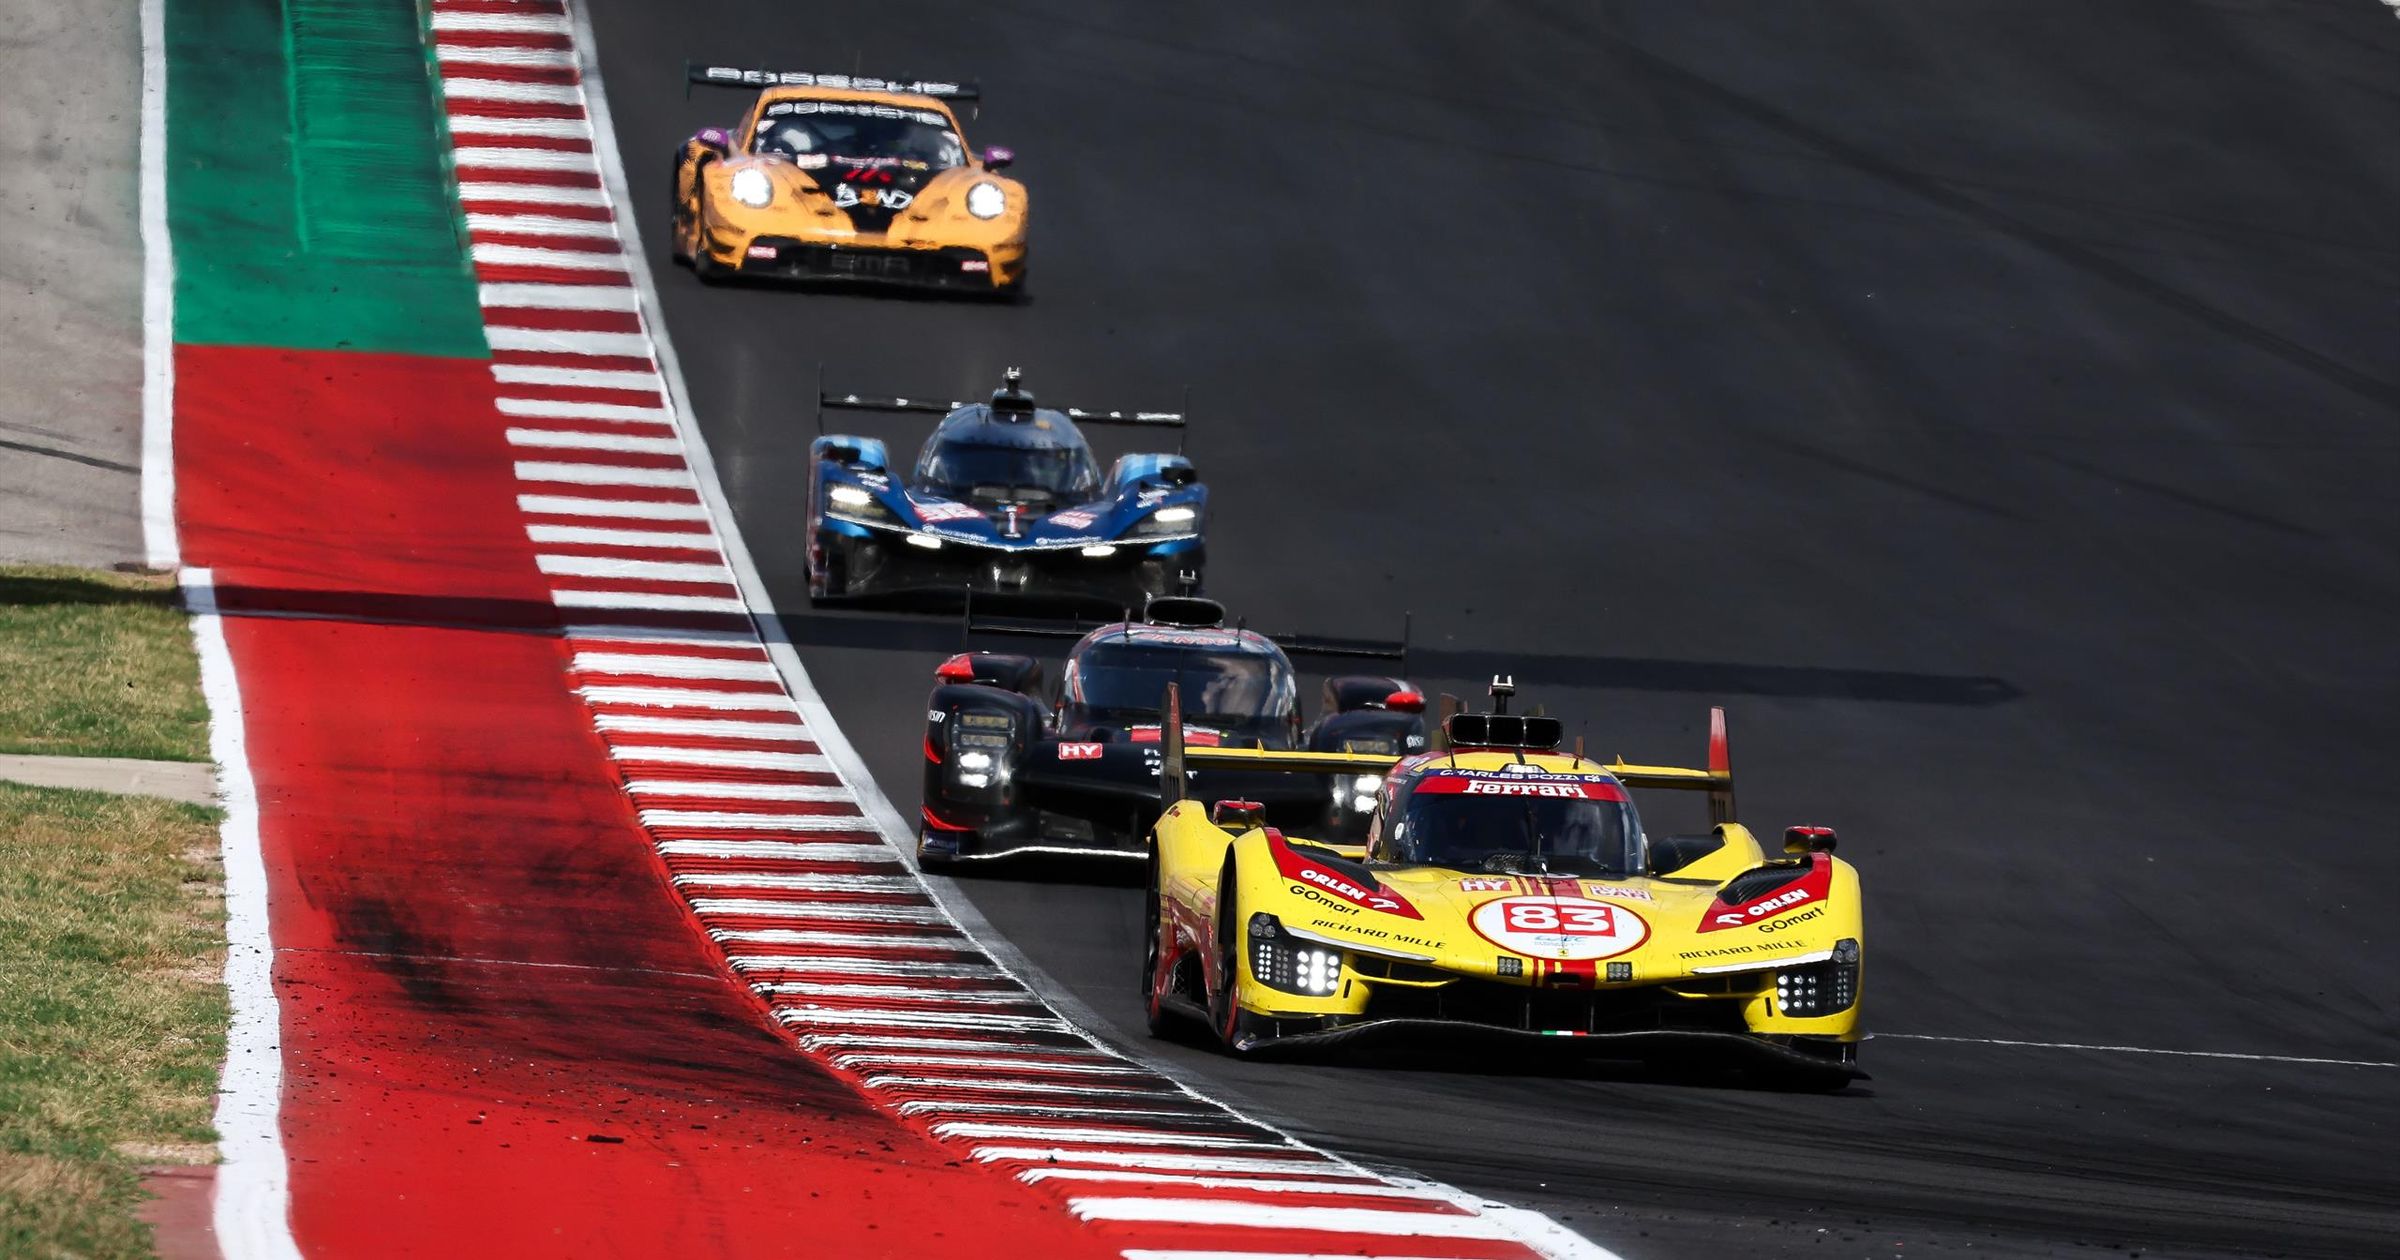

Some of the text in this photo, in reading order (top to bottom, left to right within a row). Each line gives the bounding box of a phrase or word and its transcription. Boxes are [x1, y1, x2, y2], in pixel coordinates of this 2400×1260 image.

[1061, 745, 1098, 757] HY
[1440, 769, 1524, 780] CHARLES
[1528, 773, 1580, 781] POZZI
[1462, 780, 1589, 799] Ferrari
[1300, 869, 1366, 900] ORLEN
[1461, 880, 1509, 891] HY
[1290, 885, 1361, 916] GOmart
[1748, 888, 1810, 916] ORLEN
[1509, 905, 1610, 932] 83
[1758, 907, 1825, 933] GOmart
[1311, 919, 1447, 949] RICHARD MILLE
[1679, 939, 1808, 960] RICHARD MILLE
